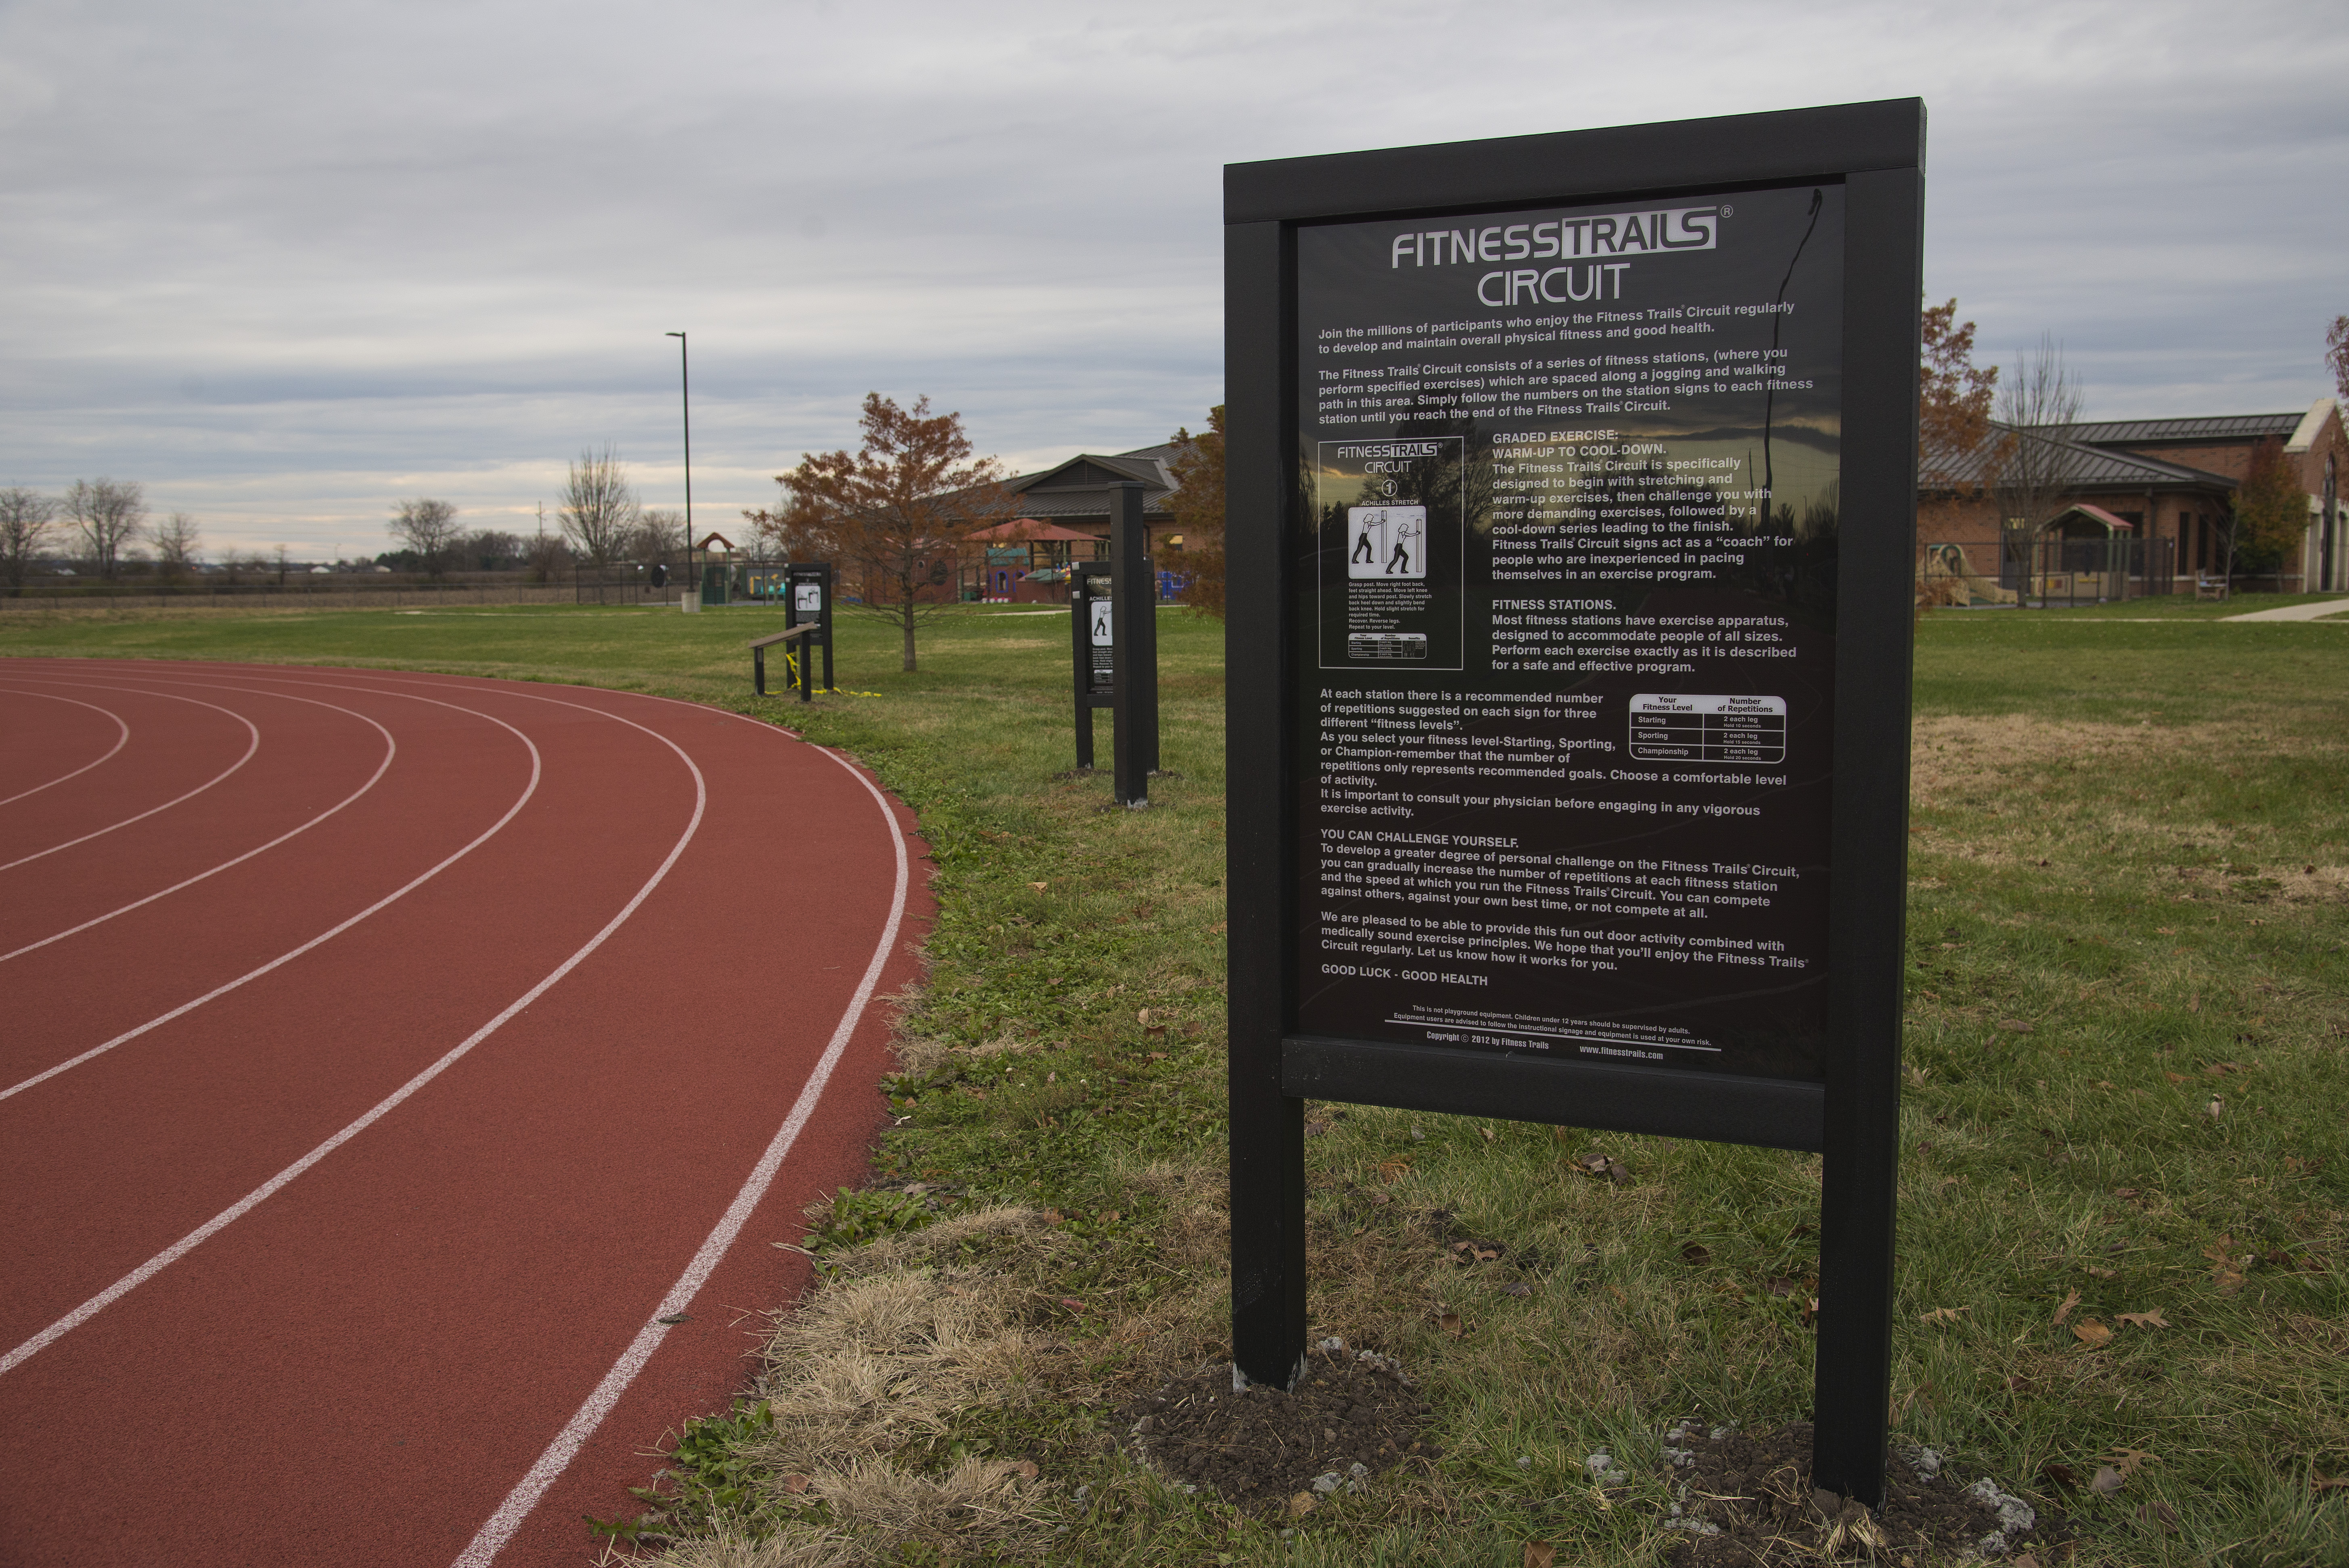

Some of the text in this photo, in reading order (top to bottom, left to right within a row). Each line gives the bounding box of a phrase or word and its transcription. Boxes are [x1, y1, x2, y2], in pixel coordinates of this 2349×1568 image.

[1477, 263, 1630, 306] CIRCUIT
[1318, 322, 1715, 354] to develop and maintain overall physical fitness and good health.
[1493, 429, 1618, 444] GRADED EXERCISE:
[1492, 443, 1666, 459] WARM-UP TO COOL-DOWN.
[1365, 461, 1411, 473] CIRCUIT
[1386, 482, 1392, 494] 1
[1493, 505, 1757, 520] more demanding exercises, followed by a
[1492, 599, 1616, 610] FITNESS STATIONS.
[1728, 705, 1773, 713] Repetitions
[1320, 717, 1368, 728] different
[1638, 716, 1666, 725] Starting
[1638, 731, 1668, 740] Sporting
[1638, 747, 1688, 756] Championship
[1320, 829, 1519, 848] YOU CAN CHALLENGE YOURSELF.
[1321, 963, 1356, 975] GOOD
[1360, 966, 1391, 978] LUCK
[1401, 969, 1437, 982] GOOD
[1441, 973, 1488, 986] HEALTH
[1394, 1012, 1425, 1021] Equipment
[1519, 1023, 1557, 1032] instructional
[1558, 1027, 1583, 1036] signage
[1597, 1031, 1631, 1039] equipment
[1445, 1008, 1478, 1016] playground
[1514, 1013, 1540, 1022] Children
[1658, 1026, 1666, 1034] by
[1426, 1031, 1459, 1042] Copyright
[1472, 1035, 1490, 1044] 2012
[1492, 1037, 1500, 1046] by
[1501, 1038, 1526, 1047] Fitness
[1528, 1040, 1549, 1049] Trails
[1579, 1046, 1663, 1059] www.fitnesstrails.com
